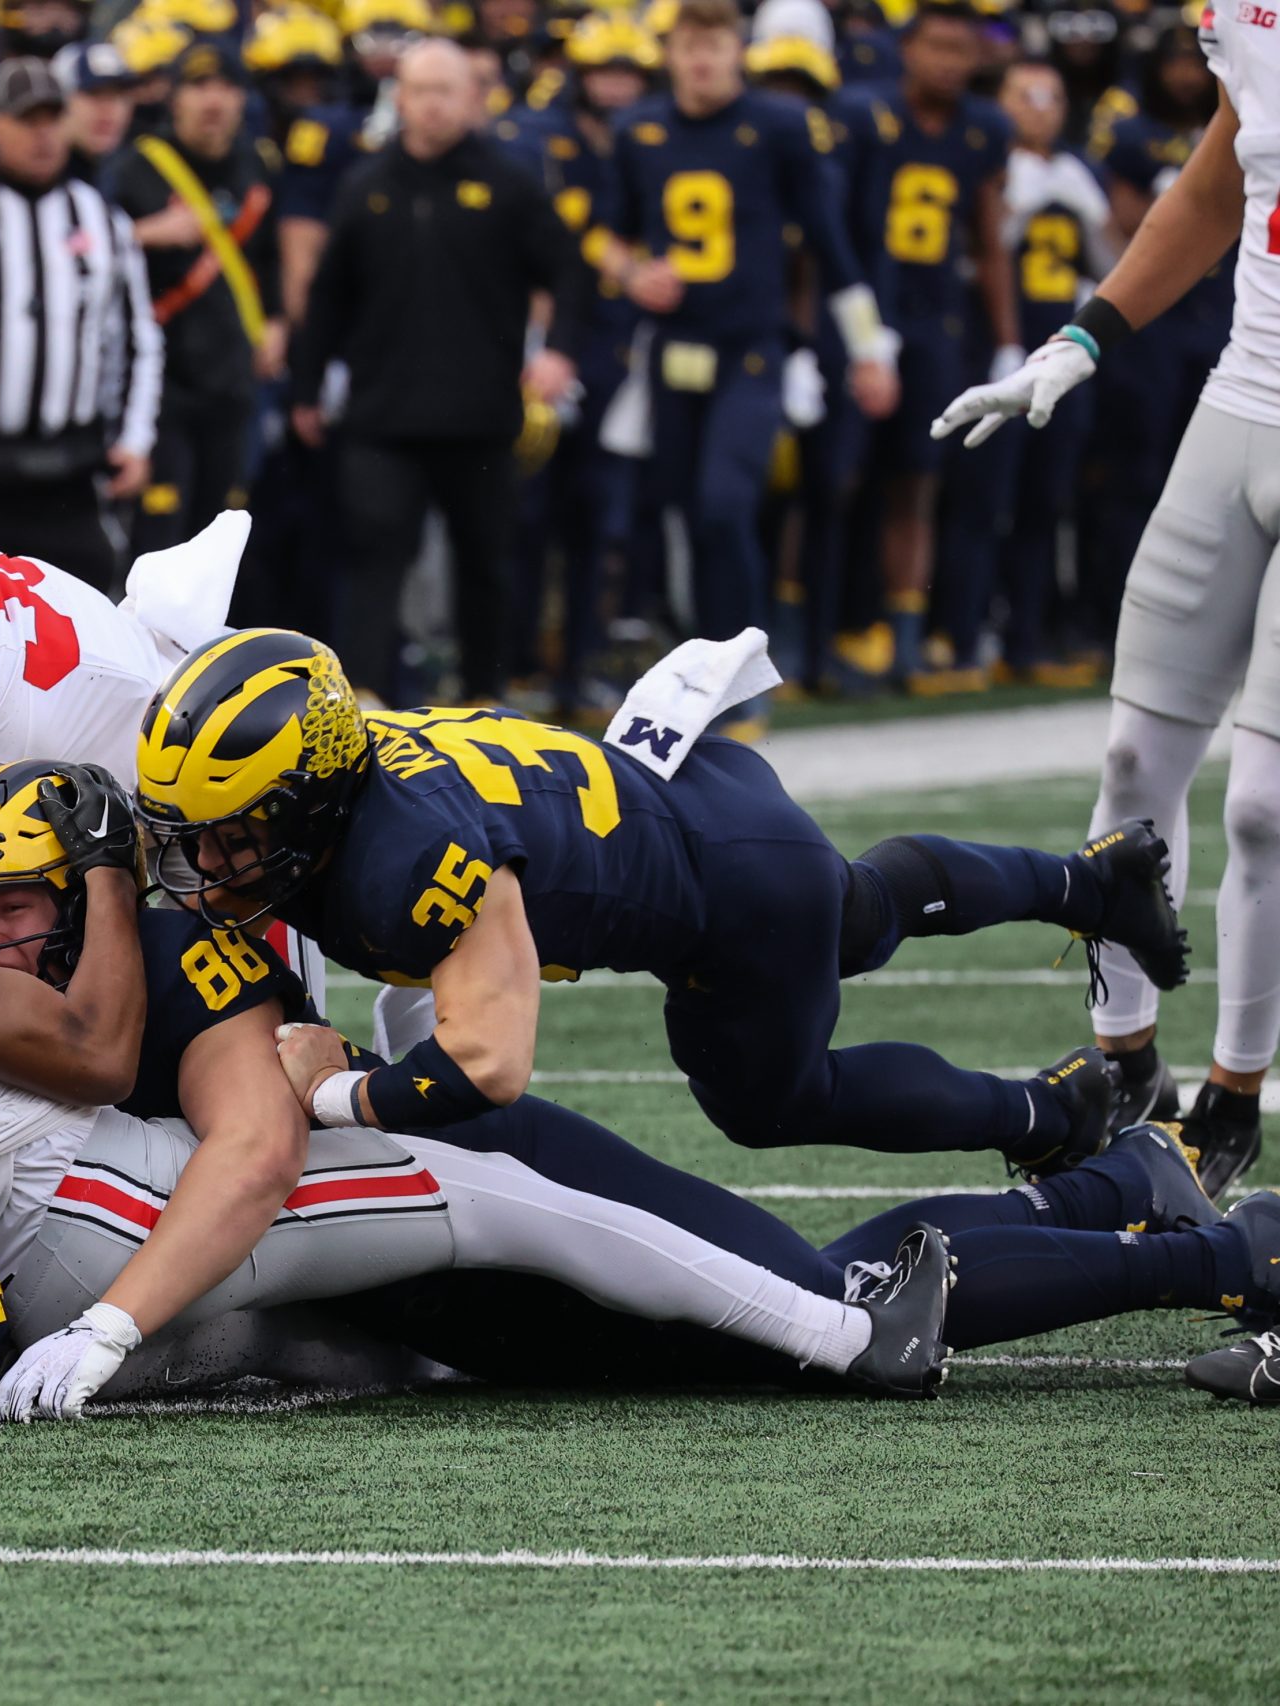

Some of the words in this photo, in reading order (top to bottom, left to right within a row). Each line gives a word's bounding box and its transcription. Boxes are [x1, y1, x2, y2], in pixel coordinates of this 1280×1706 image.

[663, 169, 734, 283] 9
[884, 161, 959, 265] 6
[1023, 212, 1079, 301] 2
[619, 716, 683, 762] M
[411, 841, 493, 949] 35
[181, 919, 269, 1011] 88
[899, 1337, 921, 1364] VAPOR
